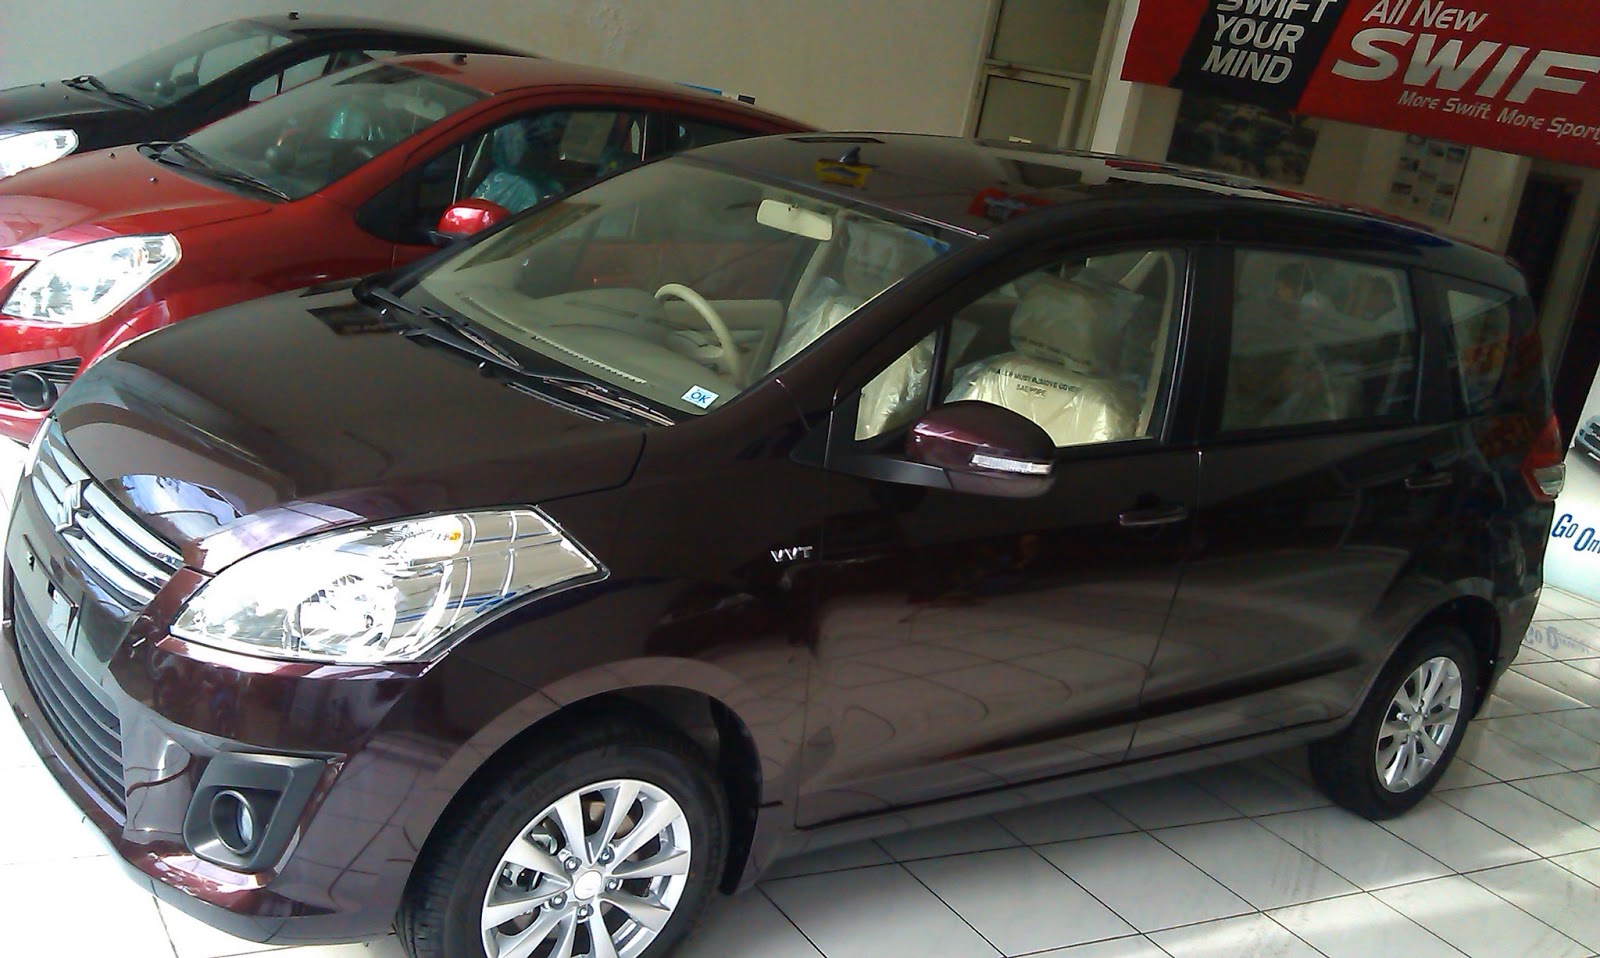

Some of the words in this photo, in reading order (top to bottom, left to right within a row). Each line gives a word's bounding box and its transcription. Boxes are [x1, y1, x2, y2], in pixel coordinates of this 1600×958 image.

[1362, 0, 1410, 25] All
[1213, 13, 1305, 54] YOUR
[1201, 45, 1293, 84] MIND
[1442, 97, 1491, 121] Swift
[1547, 116, 1600, 145] Sport
[691, 391, 711, 404] OK
[1551, 513, 1579, 538] Go
[770, 545, 813, 563] VVT
